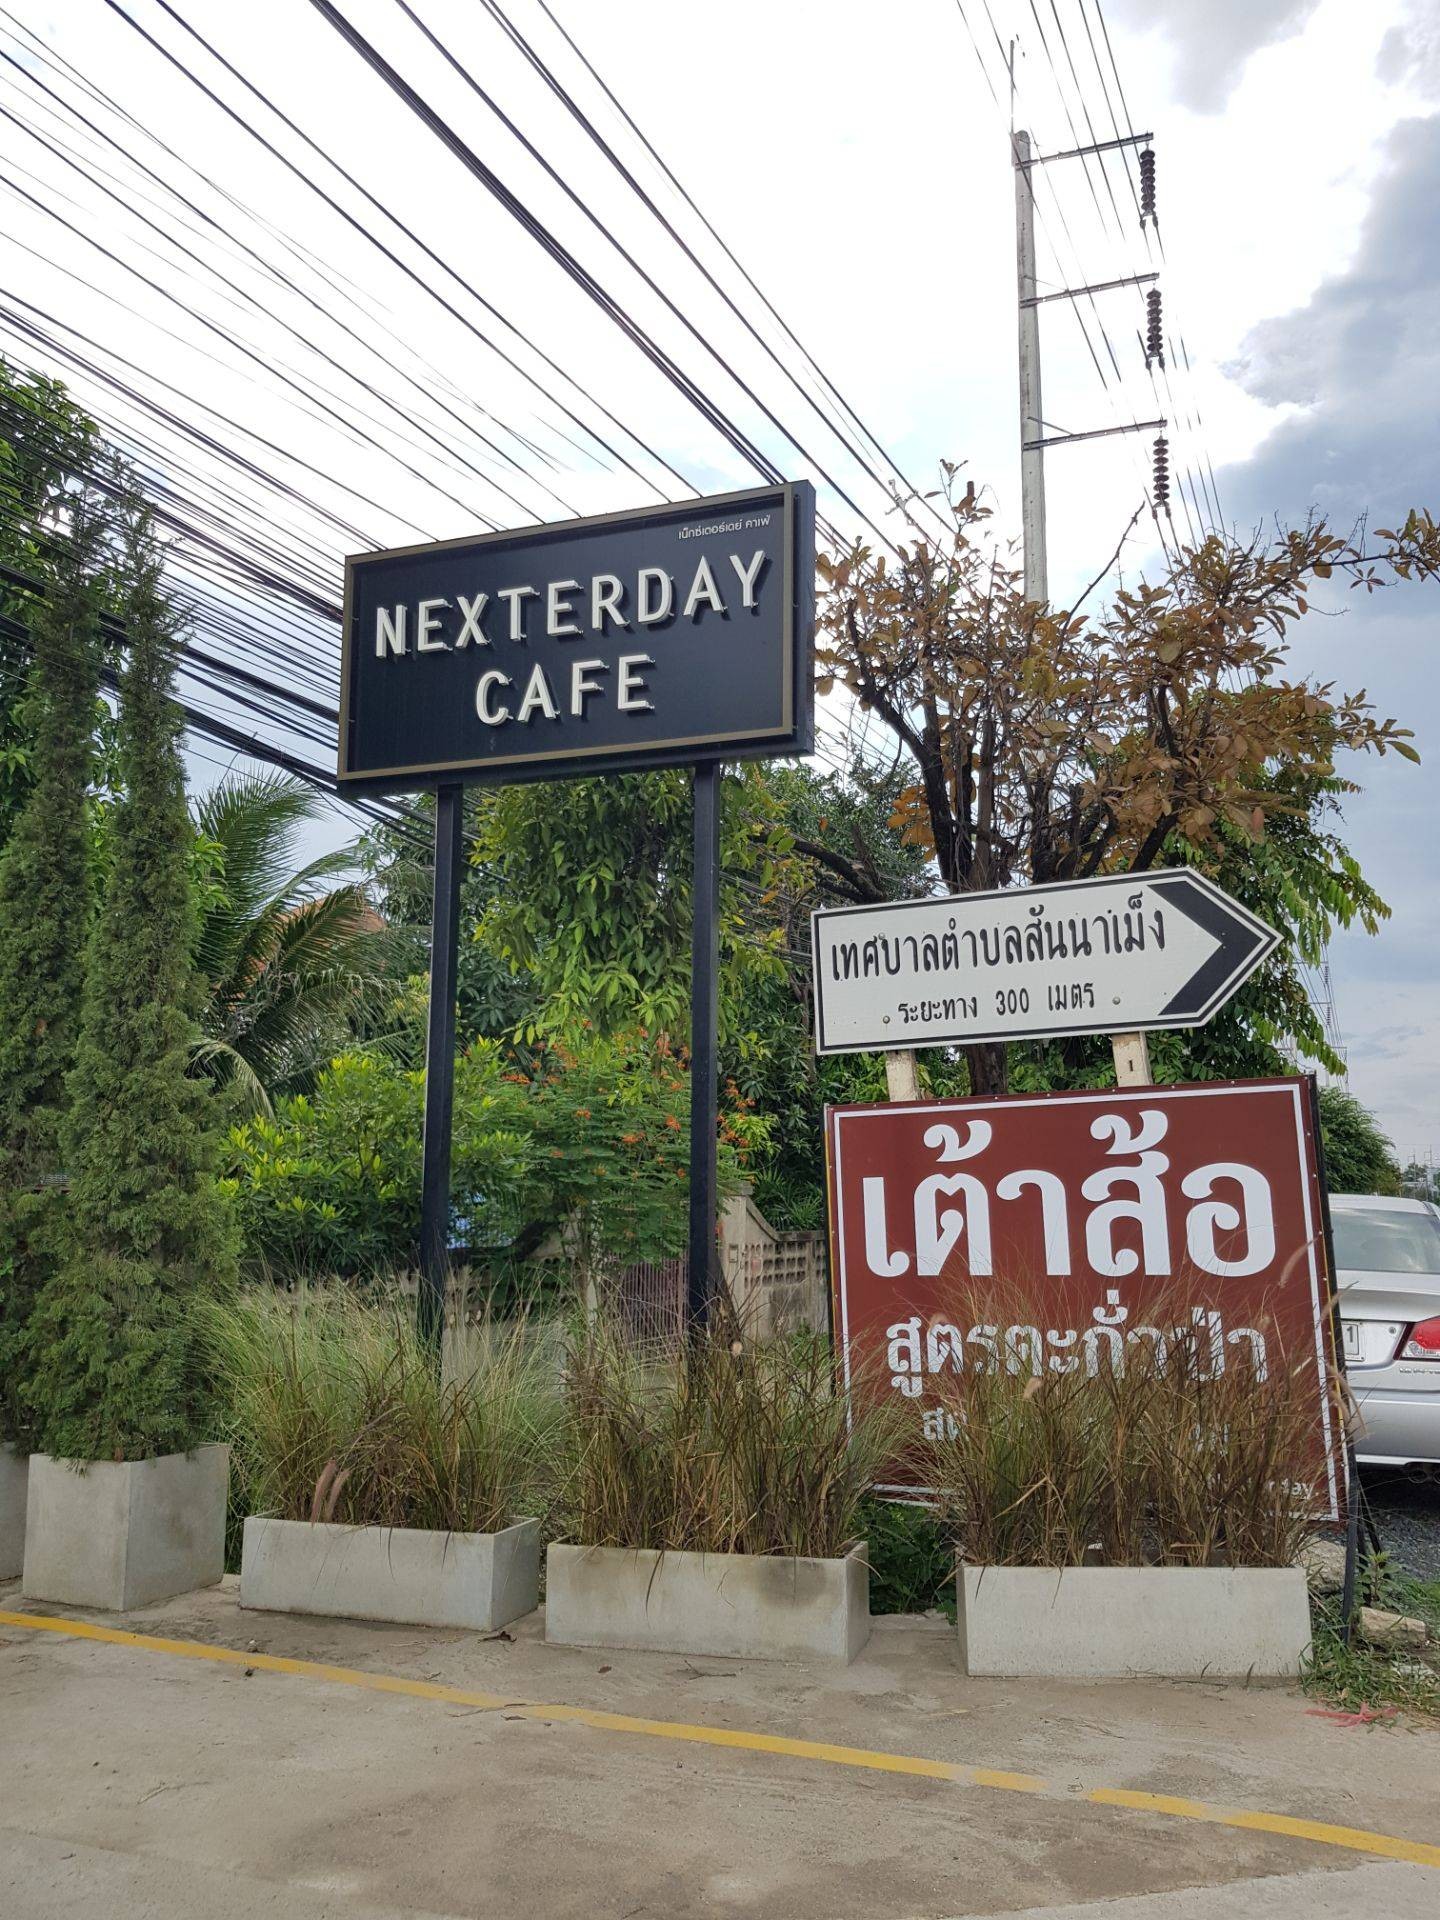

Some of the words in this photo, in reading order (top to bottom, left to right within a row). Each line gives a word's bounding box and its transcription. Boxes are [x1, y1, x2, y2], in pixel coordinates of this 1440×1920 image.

[375, 550, 767, 658] NEXTERDAY
[476, 654, 655, 727] CAFE
[832, 890, 1166, 982] เทศบาลตำบลสันนาเม็ง
[898, 994, 979, 1024] ระยะทาง
[995, 988, 1030, 1015] 300
[1047, 982, 1095, 1012] เมตร
[863, 1110, 1276, 1277] เต้าส้อ
[886, 1289, 1269, 1398] สูตรตะกั่วป่า
